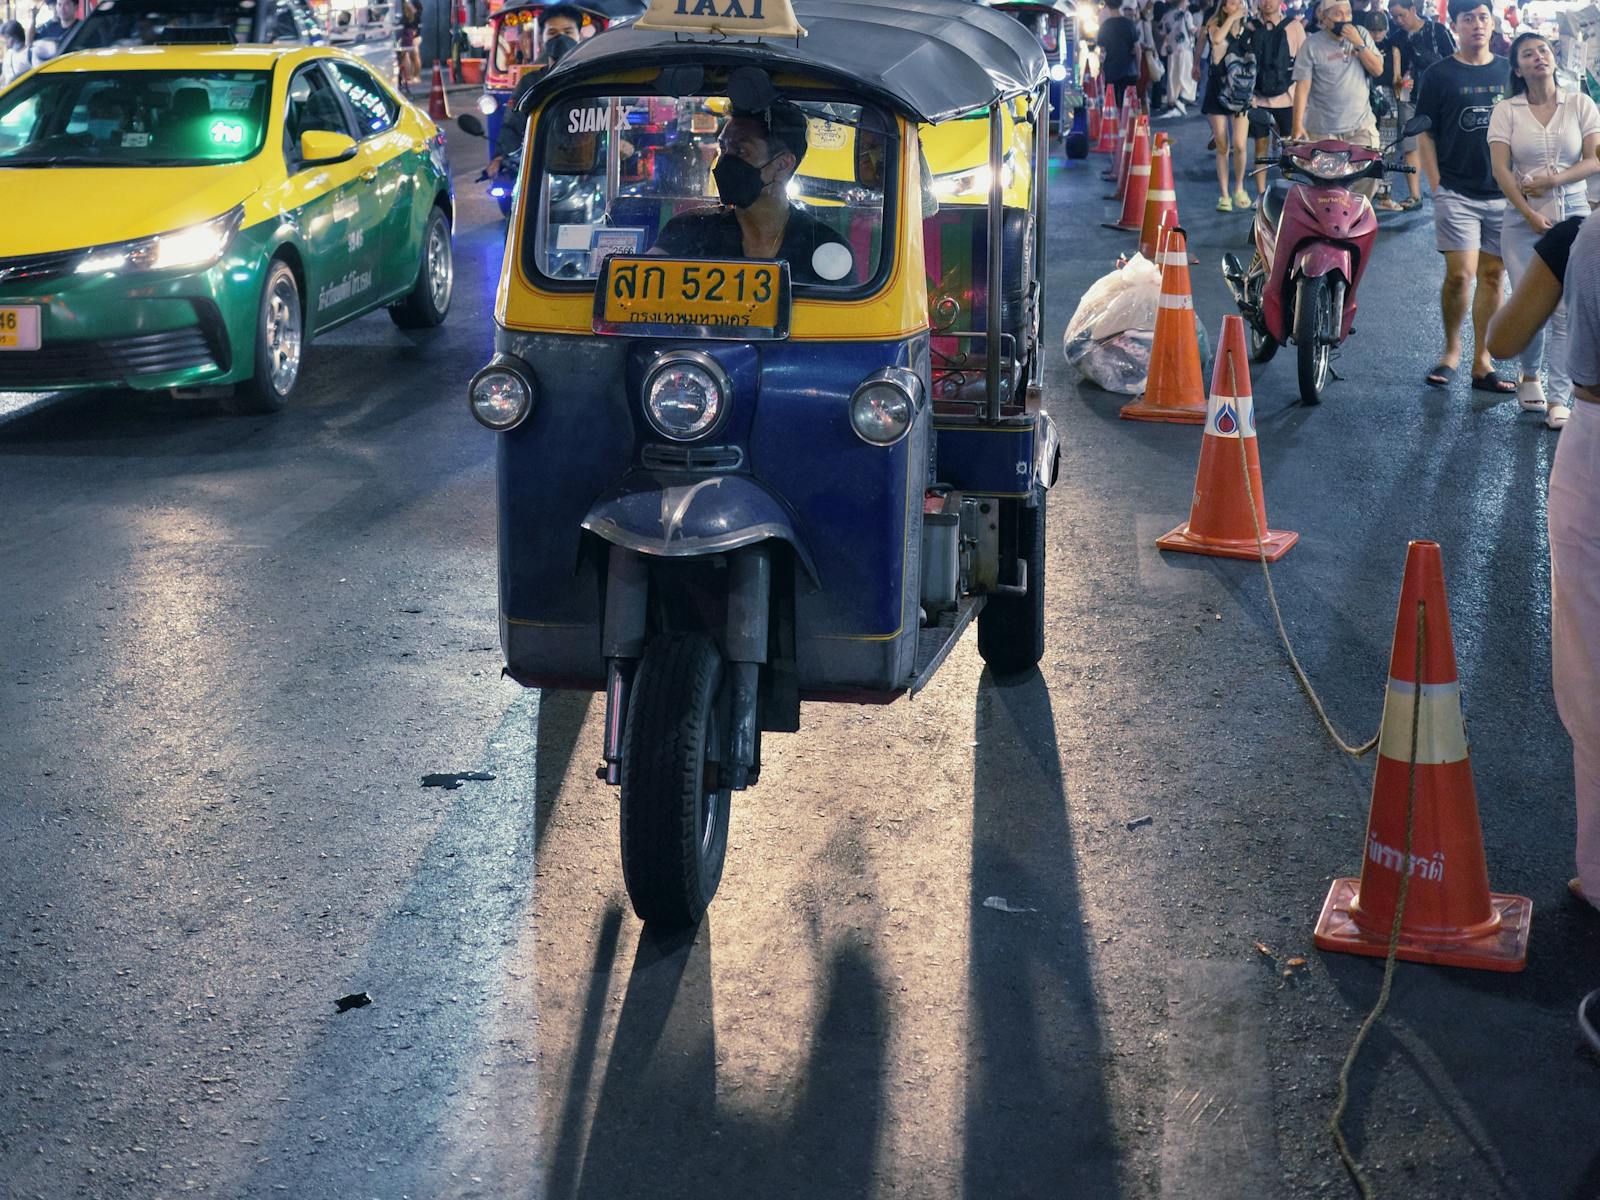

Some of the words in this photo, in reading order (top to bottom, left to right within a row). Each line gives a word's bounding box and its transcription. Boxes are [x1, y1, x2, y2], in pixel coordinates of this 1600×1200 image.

[567, 106, 612, 133] SIAM
[614, 105, 634, 131] X
[614, 263, 665, 299] สก
[681, 267, 772, 303] 5213
[629, 310, 751, 326] กรงเทพมหานคร
